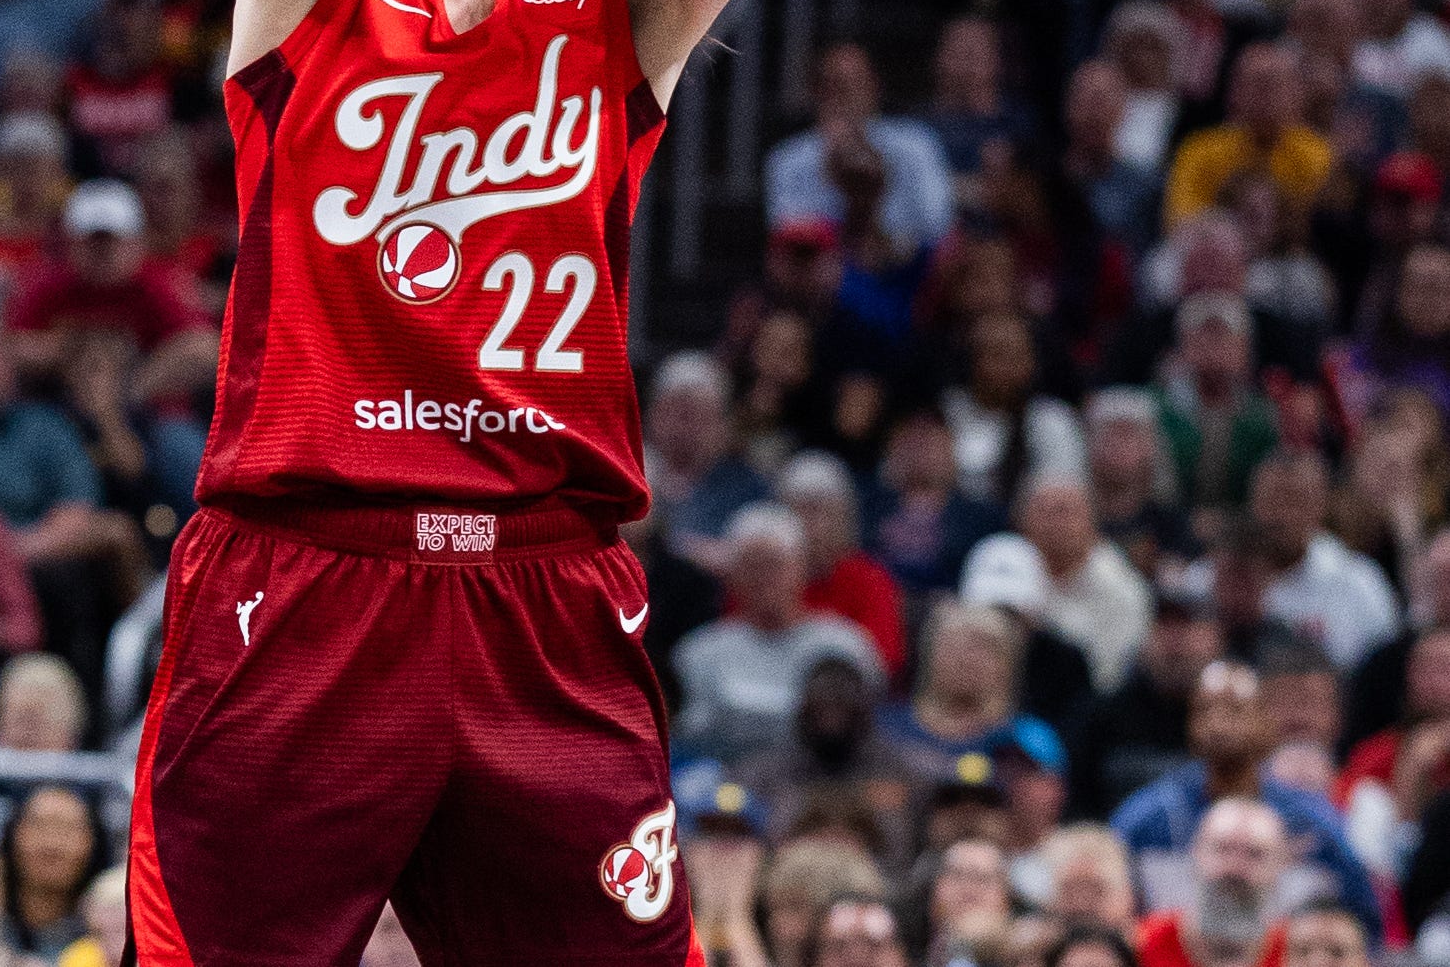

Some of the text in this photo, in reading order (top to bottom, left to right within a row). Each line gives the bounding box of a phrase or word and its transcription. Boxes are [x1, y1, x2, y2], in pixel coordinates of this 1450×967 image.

[312, 33, 603, 247] Indy
[478, 248, 599, 374] 22
[416, 513, 497, 534] EXPECT
[416, 533, 496, 552] TO WIN
